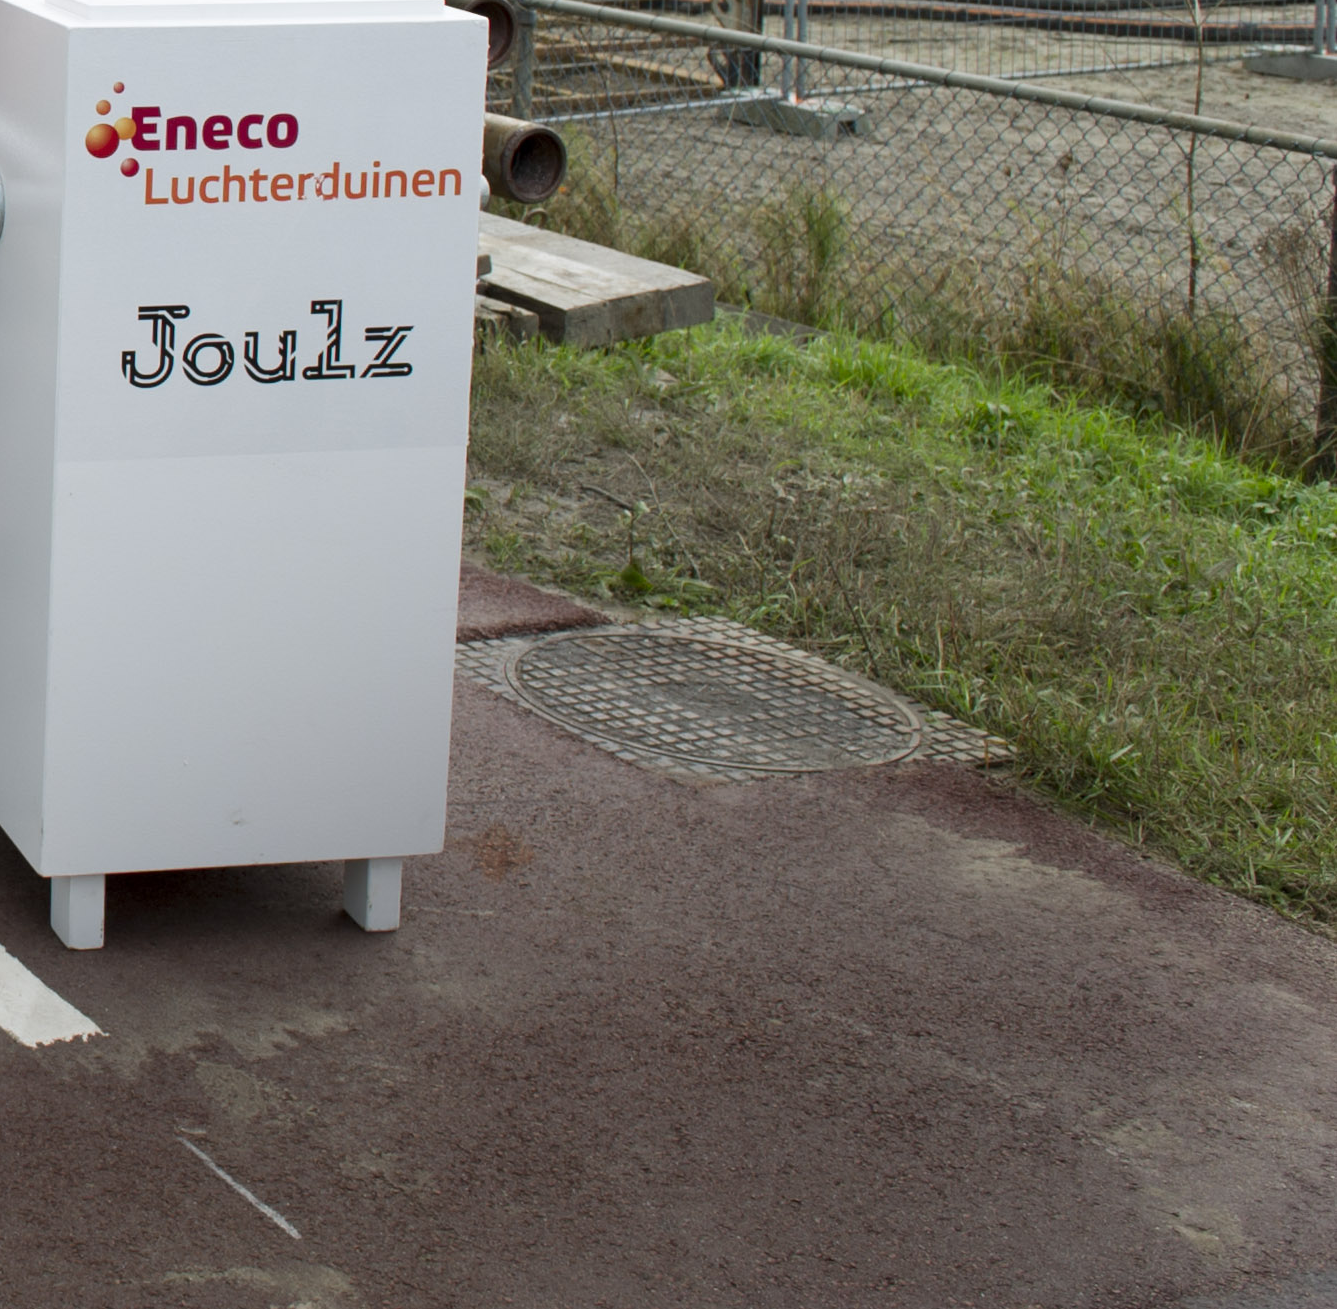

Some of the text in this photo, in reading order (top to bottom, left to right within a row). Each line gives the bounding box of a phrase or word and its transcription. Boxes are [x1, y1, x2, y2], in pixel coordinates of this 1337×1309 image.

[131, 106, 299, 151] Eneco
[144, 160, 462, 205] Luchterduinen
[121, 299, 414, 389] Joulz
